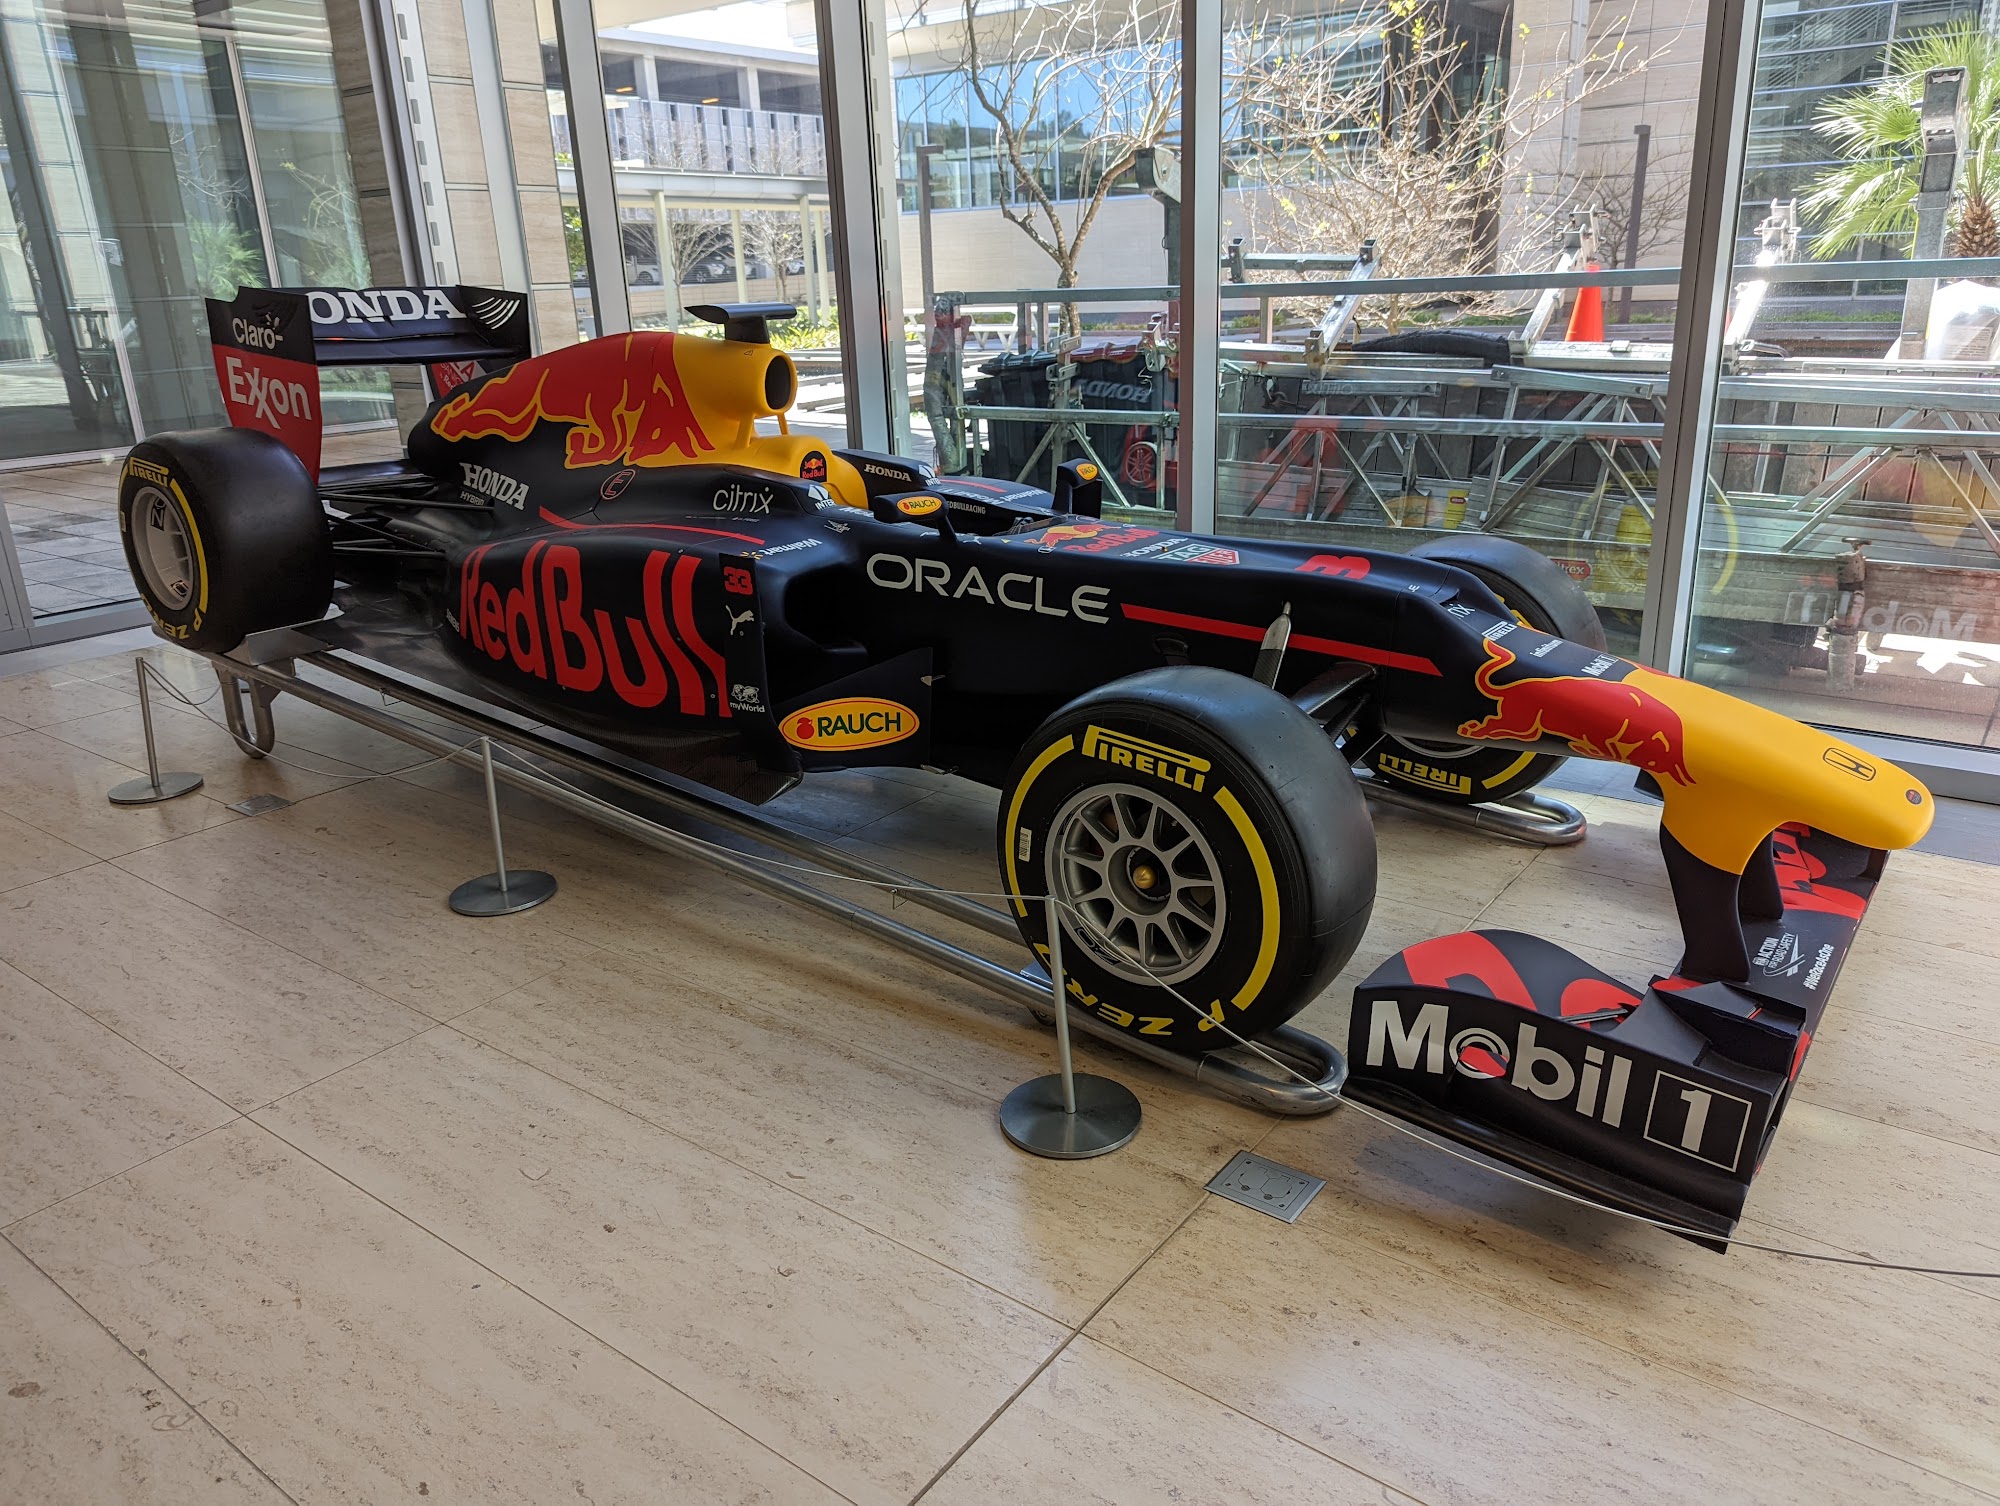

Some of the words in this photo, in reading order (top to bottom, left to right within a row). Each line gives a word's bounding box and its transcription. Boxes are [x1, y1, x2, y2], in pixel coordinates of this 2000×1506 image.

[307, 290, 468, 324] ONDA
[226, 356, 312, 430] Exxon
[129, 456, 169, 488] PIRELLI
[459, 462, 530, 511] HONDA
[863, 463, 912, 482] HONDA
[460, 490, 485, 506] HYBRID
[713, 483, 774, 514] citrix
[909, 499, 937, 509] RAUCH
[946, 501, 986, 514] EDBULLRACING
[759, 538, 823, 556] Walmart
[1157, 546, 1212, 561] TAG
[723, 566, 753, 595] 33
[866, 553, 1111, 624] ORACLE
[1481, 620, 1518, 641] PIRELLI
[730, 701, 766, 713] myWorld
[817, 711, 902, 738] RAUCH
[1081, 724, 1211, 793] PIRELLI
[1378, 752, 1472, 795] PIRELLI
[1757, 937, 1779, 959] ACTION
[1198, 998, 1225, 1032] P
[1366, 1000, 1636, 1128] Mobil
[1680, 1088, 1712, 1153] 1
